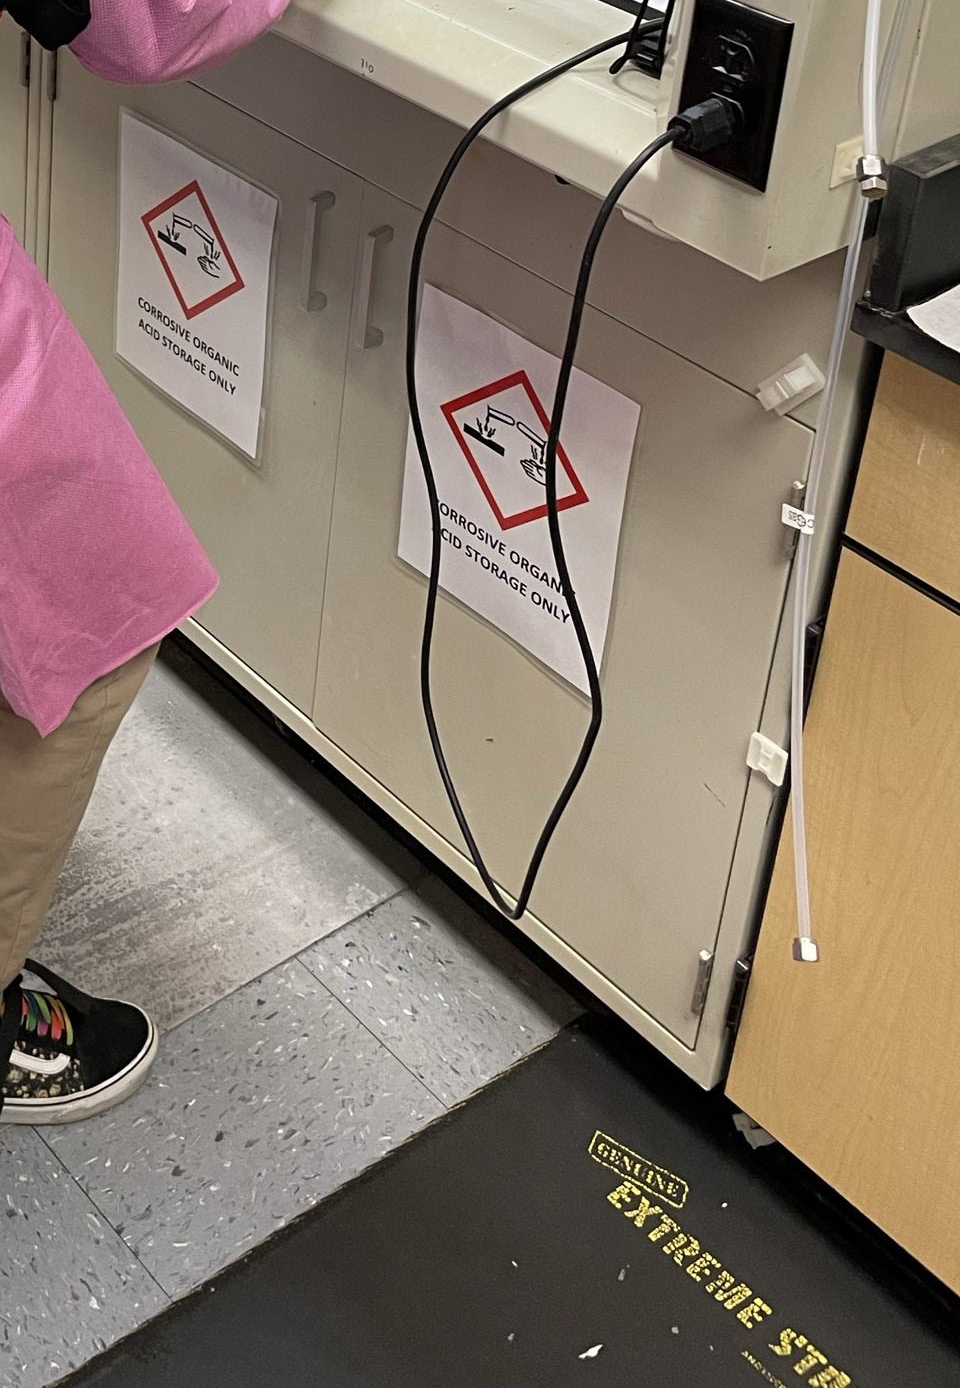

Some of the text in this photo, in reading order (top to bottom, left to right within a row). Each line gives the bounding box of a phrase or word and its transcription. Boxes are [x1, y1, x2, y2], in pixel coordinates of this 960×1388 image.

[138, 297, 239, 376] CORROSIVE ORGANIC
[138, 319, 236, 395] ACID STORAGE ONLY
[438, 500, 575, 597] ORROSIVE ORGAN
[440, 527, 570, 624] CID STORAGE ONLY
[597, 1143, 679, 1197] GENUINE
[607, 1180, 773, 1329] EXTREME
